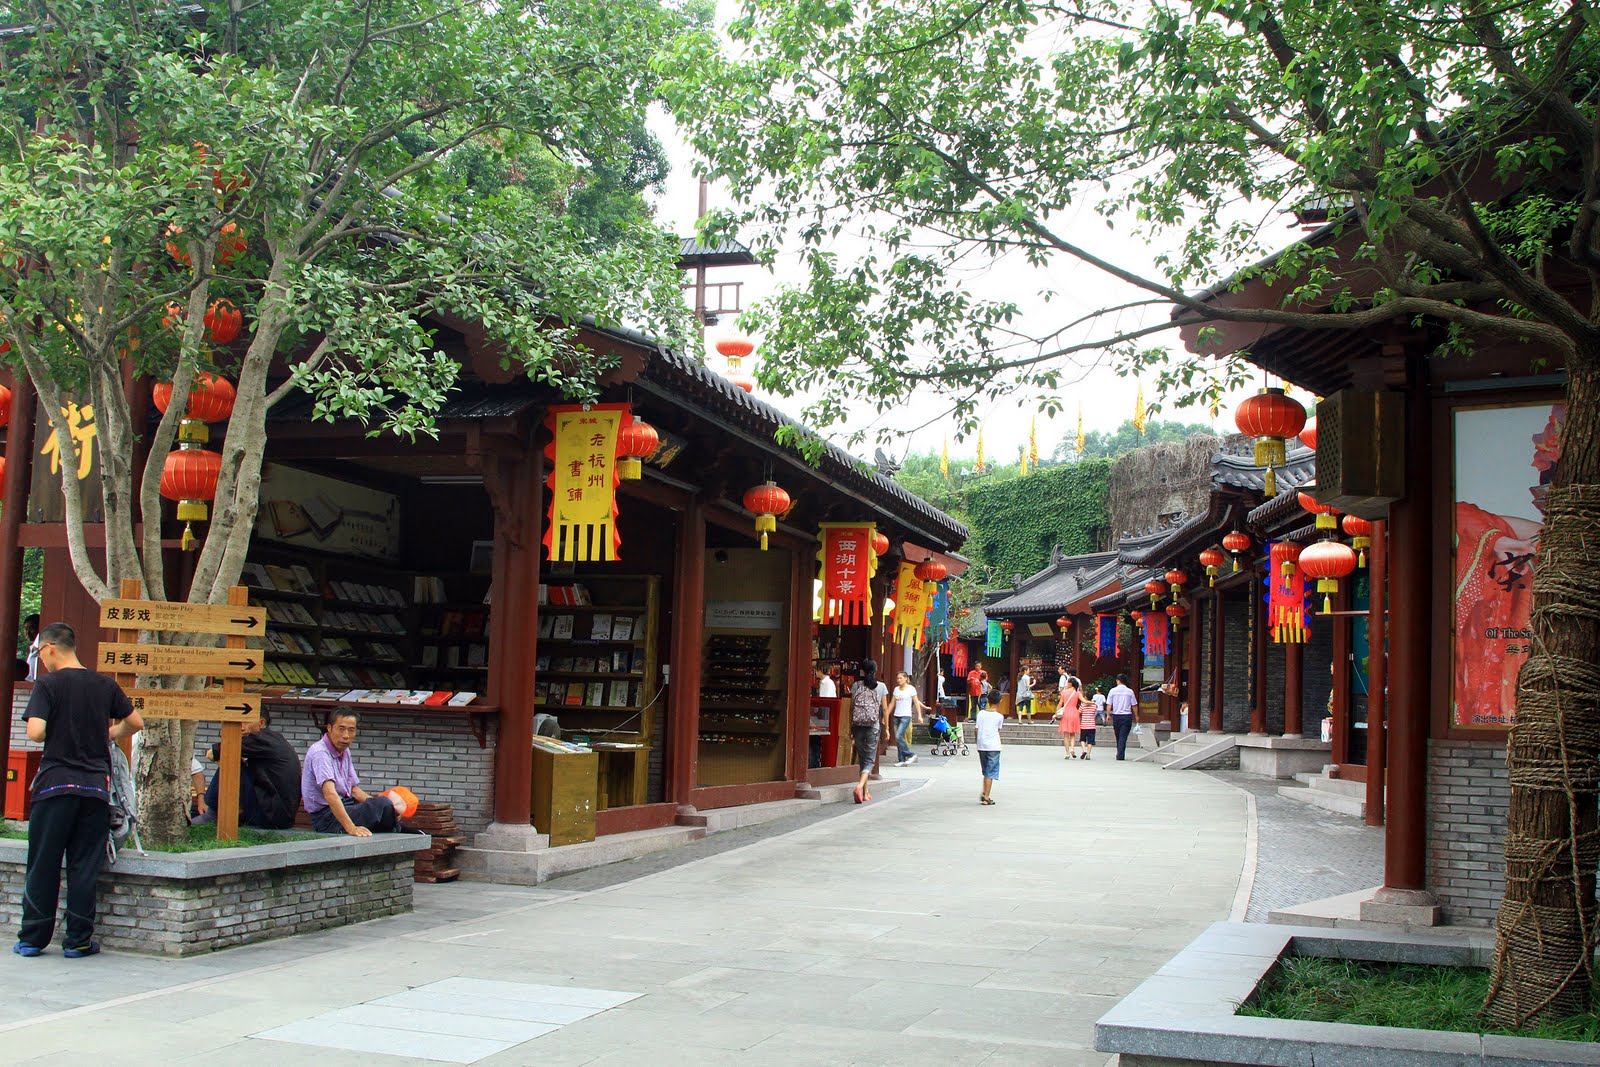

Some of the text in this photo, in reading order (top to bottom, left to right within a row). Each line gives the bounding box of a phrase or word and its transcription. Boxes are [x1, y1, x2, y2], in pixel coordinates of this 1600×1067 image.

[588, 433, 606, 488] 老杭州
[836, 540, 857, 594] 西湖十景
[107, 607, 150, 622] 皮影戏
[155, 603, 179, 611] Shadow
[1485, 627, 1532, 638] Of The So
[104, 651, 149, 666] 月老祠
[195, 649, 215, 657] Temple
